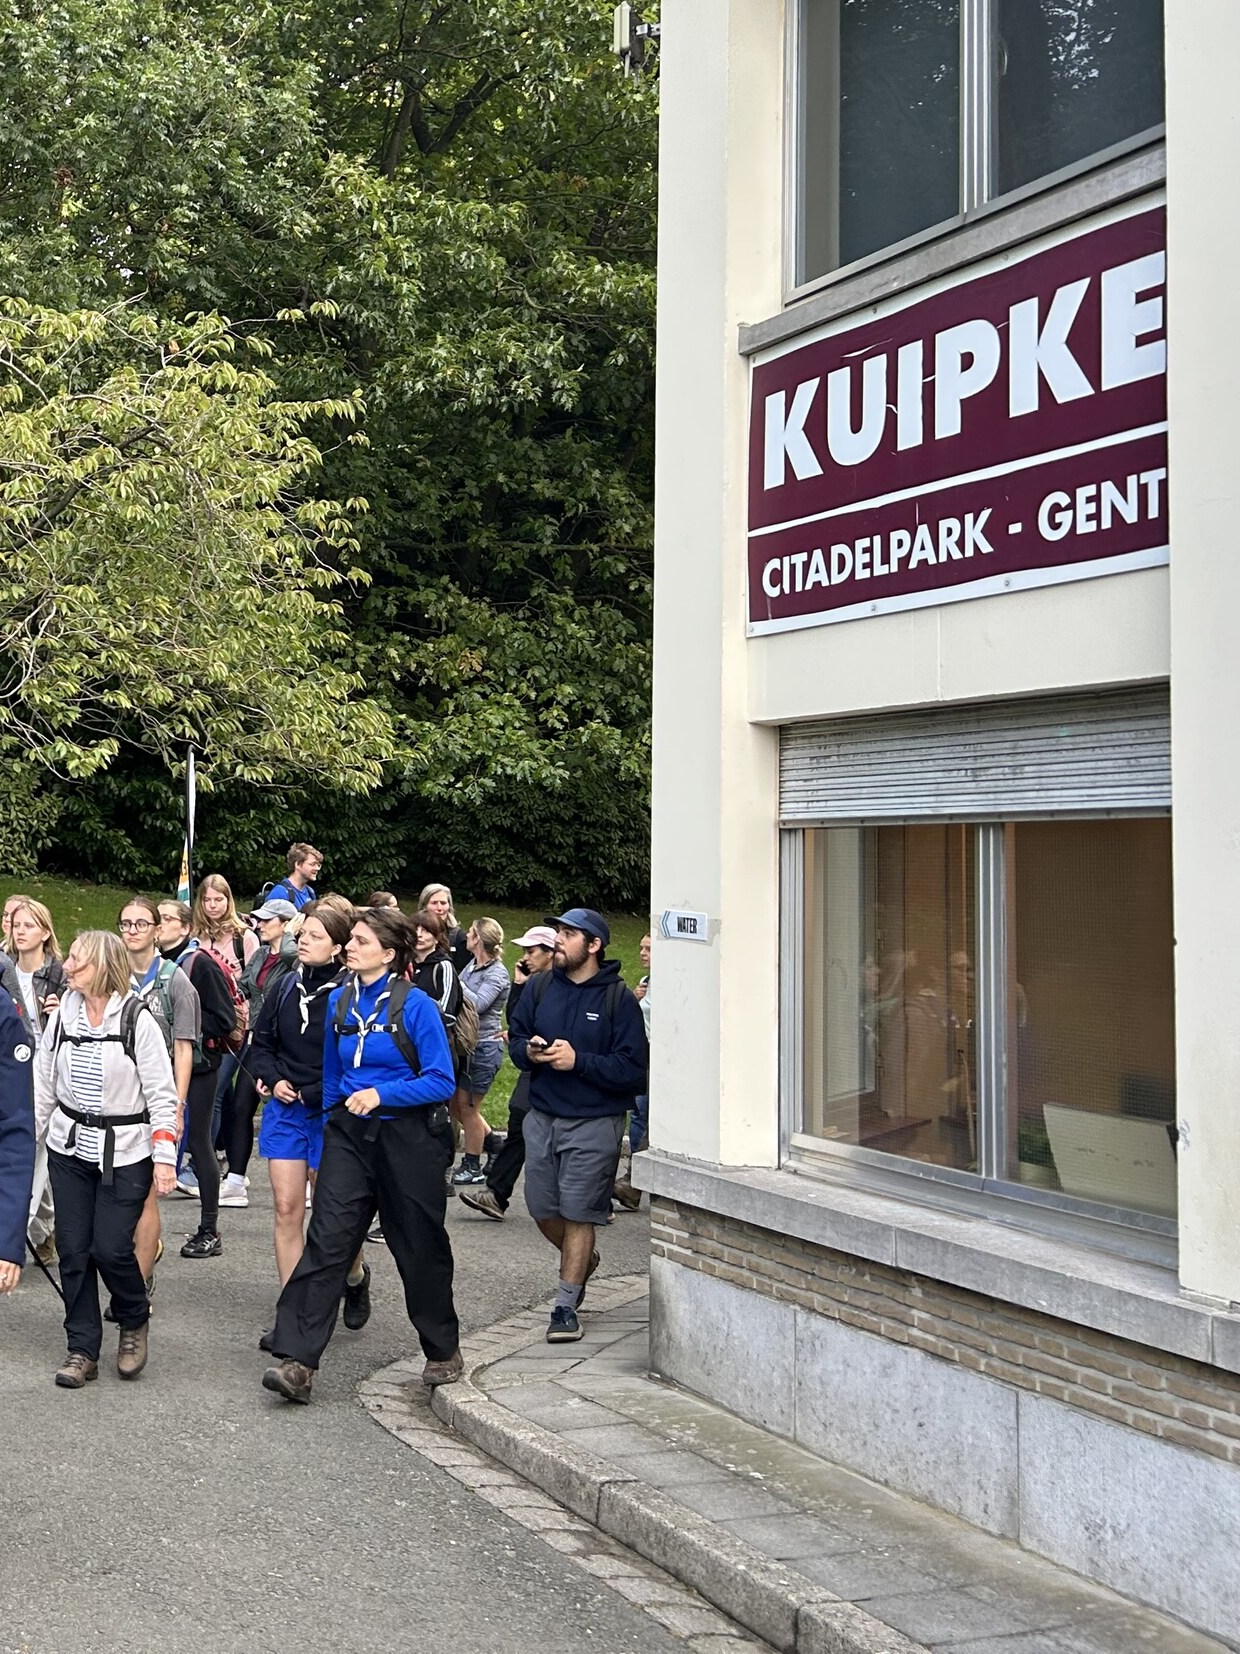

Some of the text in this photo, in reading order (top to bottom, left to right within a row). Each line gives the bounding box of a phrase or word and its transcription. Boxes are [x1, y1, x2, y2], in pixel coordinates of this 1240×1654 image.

[763, 250, 1166, 491] KUIPKE
[761, 508, 994, 598] CITADELPARK
[1037, 467, 1166, 542] GENT
[677, 916, 697, 934] WATER
